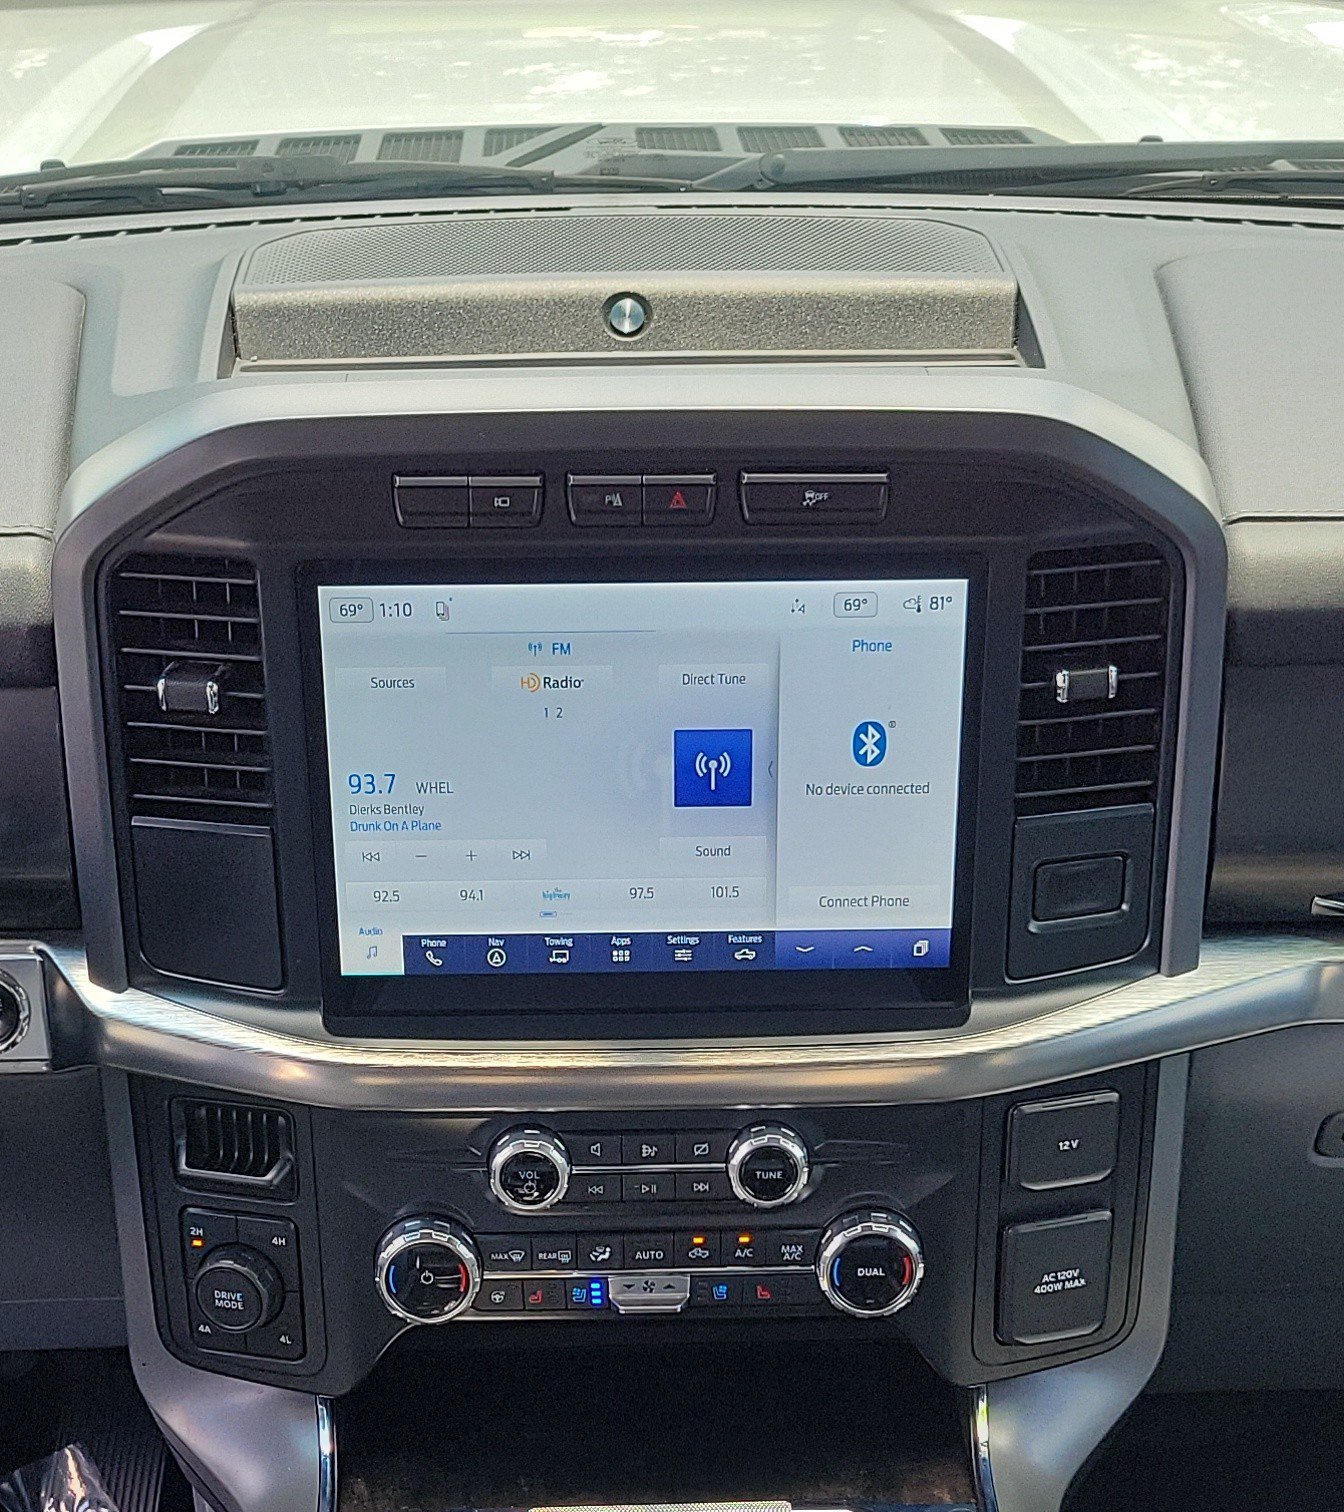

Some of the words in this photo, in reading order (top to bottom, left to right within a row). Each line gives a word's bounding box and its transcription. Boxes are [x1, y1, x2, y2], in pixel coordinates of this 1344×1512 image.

[378, 602, 413, 618] 1:10
[551, 642, 572, 656] FM
[852, 639, 893, 653] Phone
[370, 676, 415, 689] Sources
[543, 675, 582, 689] Radio
[681, 673, 715, 686] Direct
[717, 673, 747, 685] Tune
[543, 707, 549, 719] 1
[555, 707, 563, 719] 2
[348, 773, 396, 795] 93.7
[415, 781, 454, 795] WHEL
[805, 784, 824, 796] No
[825, 783, 865, 796] device
[866, 782, 931, 796] connected
[349, 803, 382, 816] Dierks
[383, 803, 425, 817] Bentley
[350, 820, 382, 832] Drunk
[383, 820, 400, 832] On
[401, 820, 410, 831] A
[411, 820, 442, 831] Plane
[695, 844, 732, 857] Sound
[372, 890, 400, 903] 92.5
[459, 889, 484, 901] 94.1
[629, 887, 655, 900] 97.5
[710, 886, 740, 899] 101.5
[819, 896, 869, 908] Connect
[871, 895, 910, 908] Phone
[358, 926, 384, 937] Audio
[420, 938, 447, 948] Phone
[488, 937, 505, 948] Nav
[544, 936, 574, 949] Towing
[610, 936, 632, 947] Apps
[666, 934, 700, 946] Settings
[727, 934, 763, 944] Features
[518, 1170, 540, 1180] VOL
[755, 1170, 784, 1180] TUNE
[189, 1226, 204, 1237] 2H
[271, 1236, 287, 1247] 4H
[734, 1247, 754, 1258] A/C
[781, 1244, 804, 1254] MAX
[490, 1251, 509, 1261] MAX
[537, 1251, 557, 1261] REAR
[634, 1250, 664, 1261] AUTO
[782, 1251, 802, 1261] A/C
[856, 1265, 886, 1277] DUAL
[1041, 1272, 1057, 1283] AC
[1057, 1268, 1080, 1281] 120V
[1033, 1281, 1064, 1295] 400W
[1064, 1277, 1087, 1289] MAX
[213, 1289, 243, 1302] DRIVE
[214, 1299, 245, 1310] MODE
[197, 1324, 212, 1335] 4A
[279, 1334, 293, 1346] 4L
